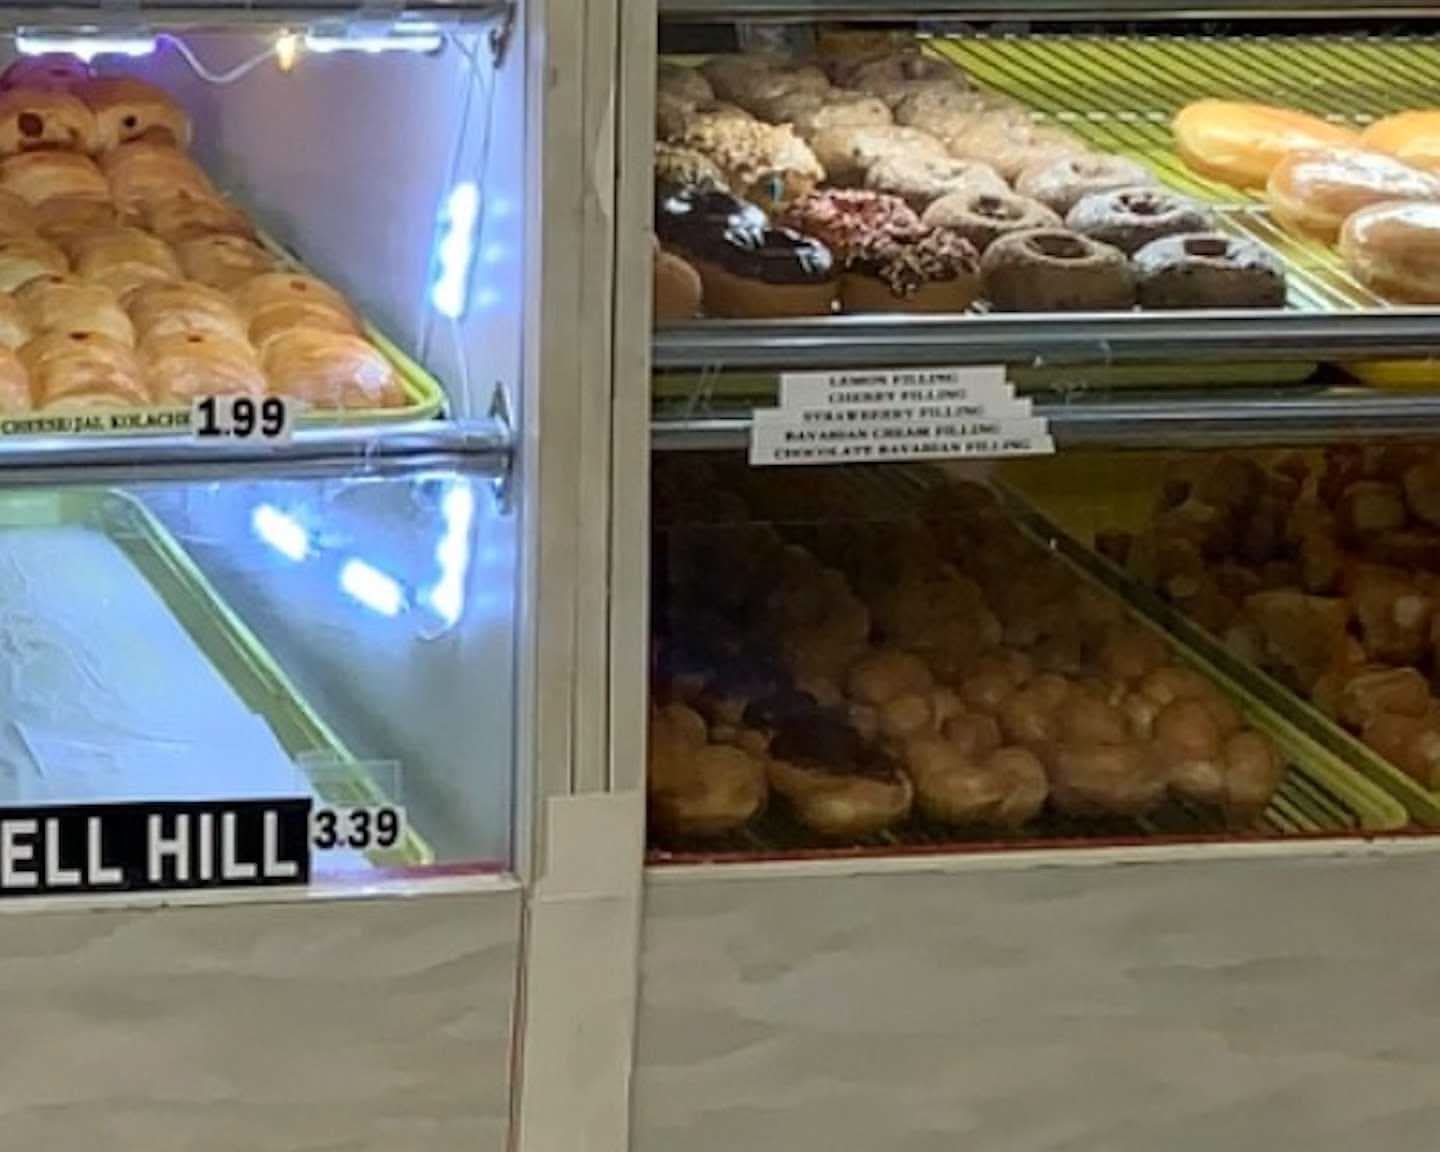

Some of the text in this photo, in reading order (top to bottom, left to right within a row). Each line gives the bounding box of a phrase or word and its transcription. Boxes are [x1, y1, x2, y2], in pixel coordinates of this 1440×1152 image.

[828, 373, 959, 387] LEMON FILLING
[828, 389, 965, 404] CHERRY FILLING
[197, 396, 285, 437] 1.99
[803, 405, 984, 422] STRAWBERRY FILLING
[785, 423, 1000, 443] BAVARIAN CREAM FILLING
[774, 447, 872, 460] CHOCOLATE
[965, 440, 1032, 453] FILLING
[312, 809, 400, 849] 3.39
[147, 810, 298, 882] HILL
